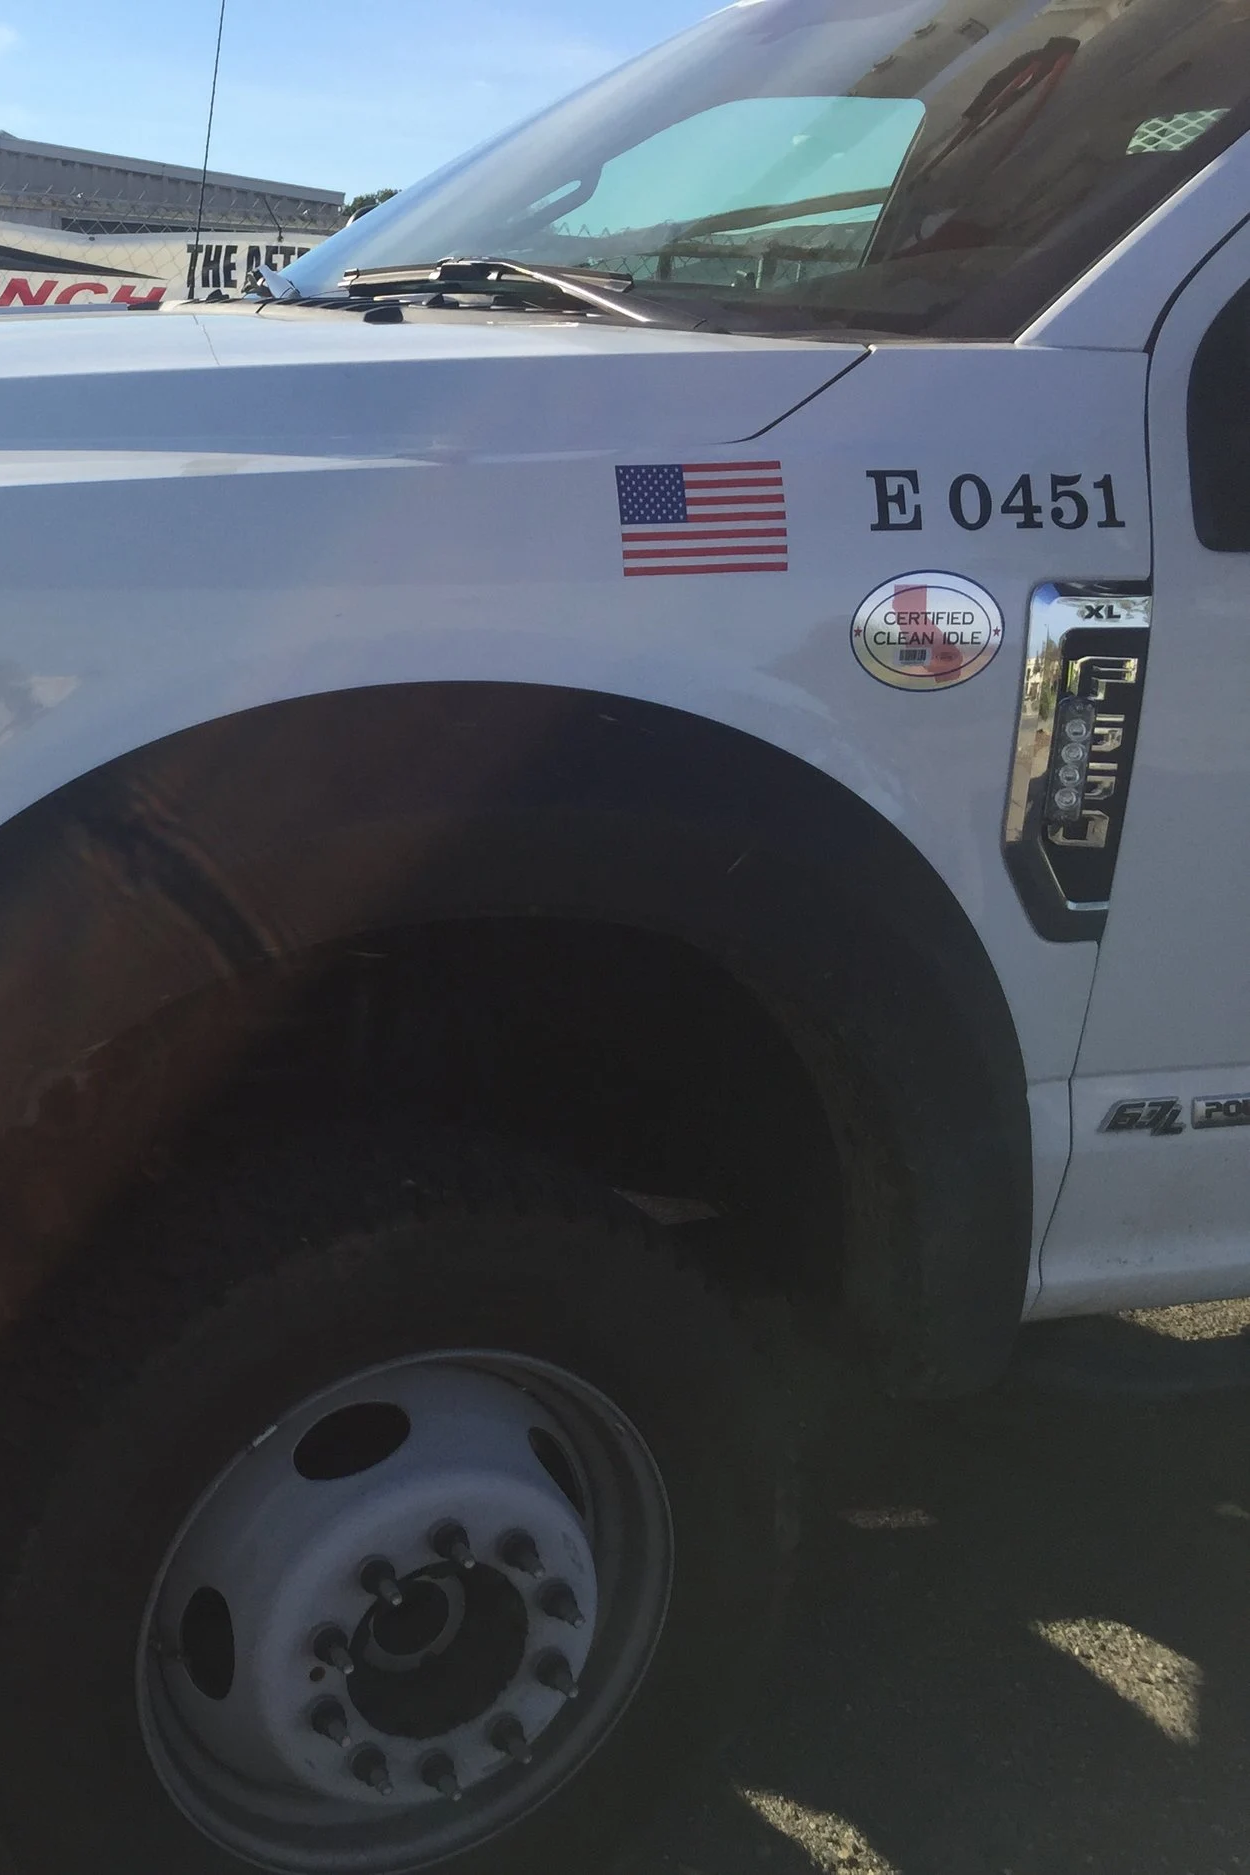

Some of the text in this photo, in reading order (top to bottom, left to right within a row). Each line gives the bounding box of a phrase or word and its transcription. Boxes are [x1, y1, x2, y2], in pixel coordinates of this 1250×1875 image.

[187, 244, 238, 288] THE
[865, 469, 1126, 531] E 0451
[883, 611, 975, 626] CERTIFIED
[1084, 604, 1122, 620] XL
[873, 631, 982, 645] CLEAN IDLE
